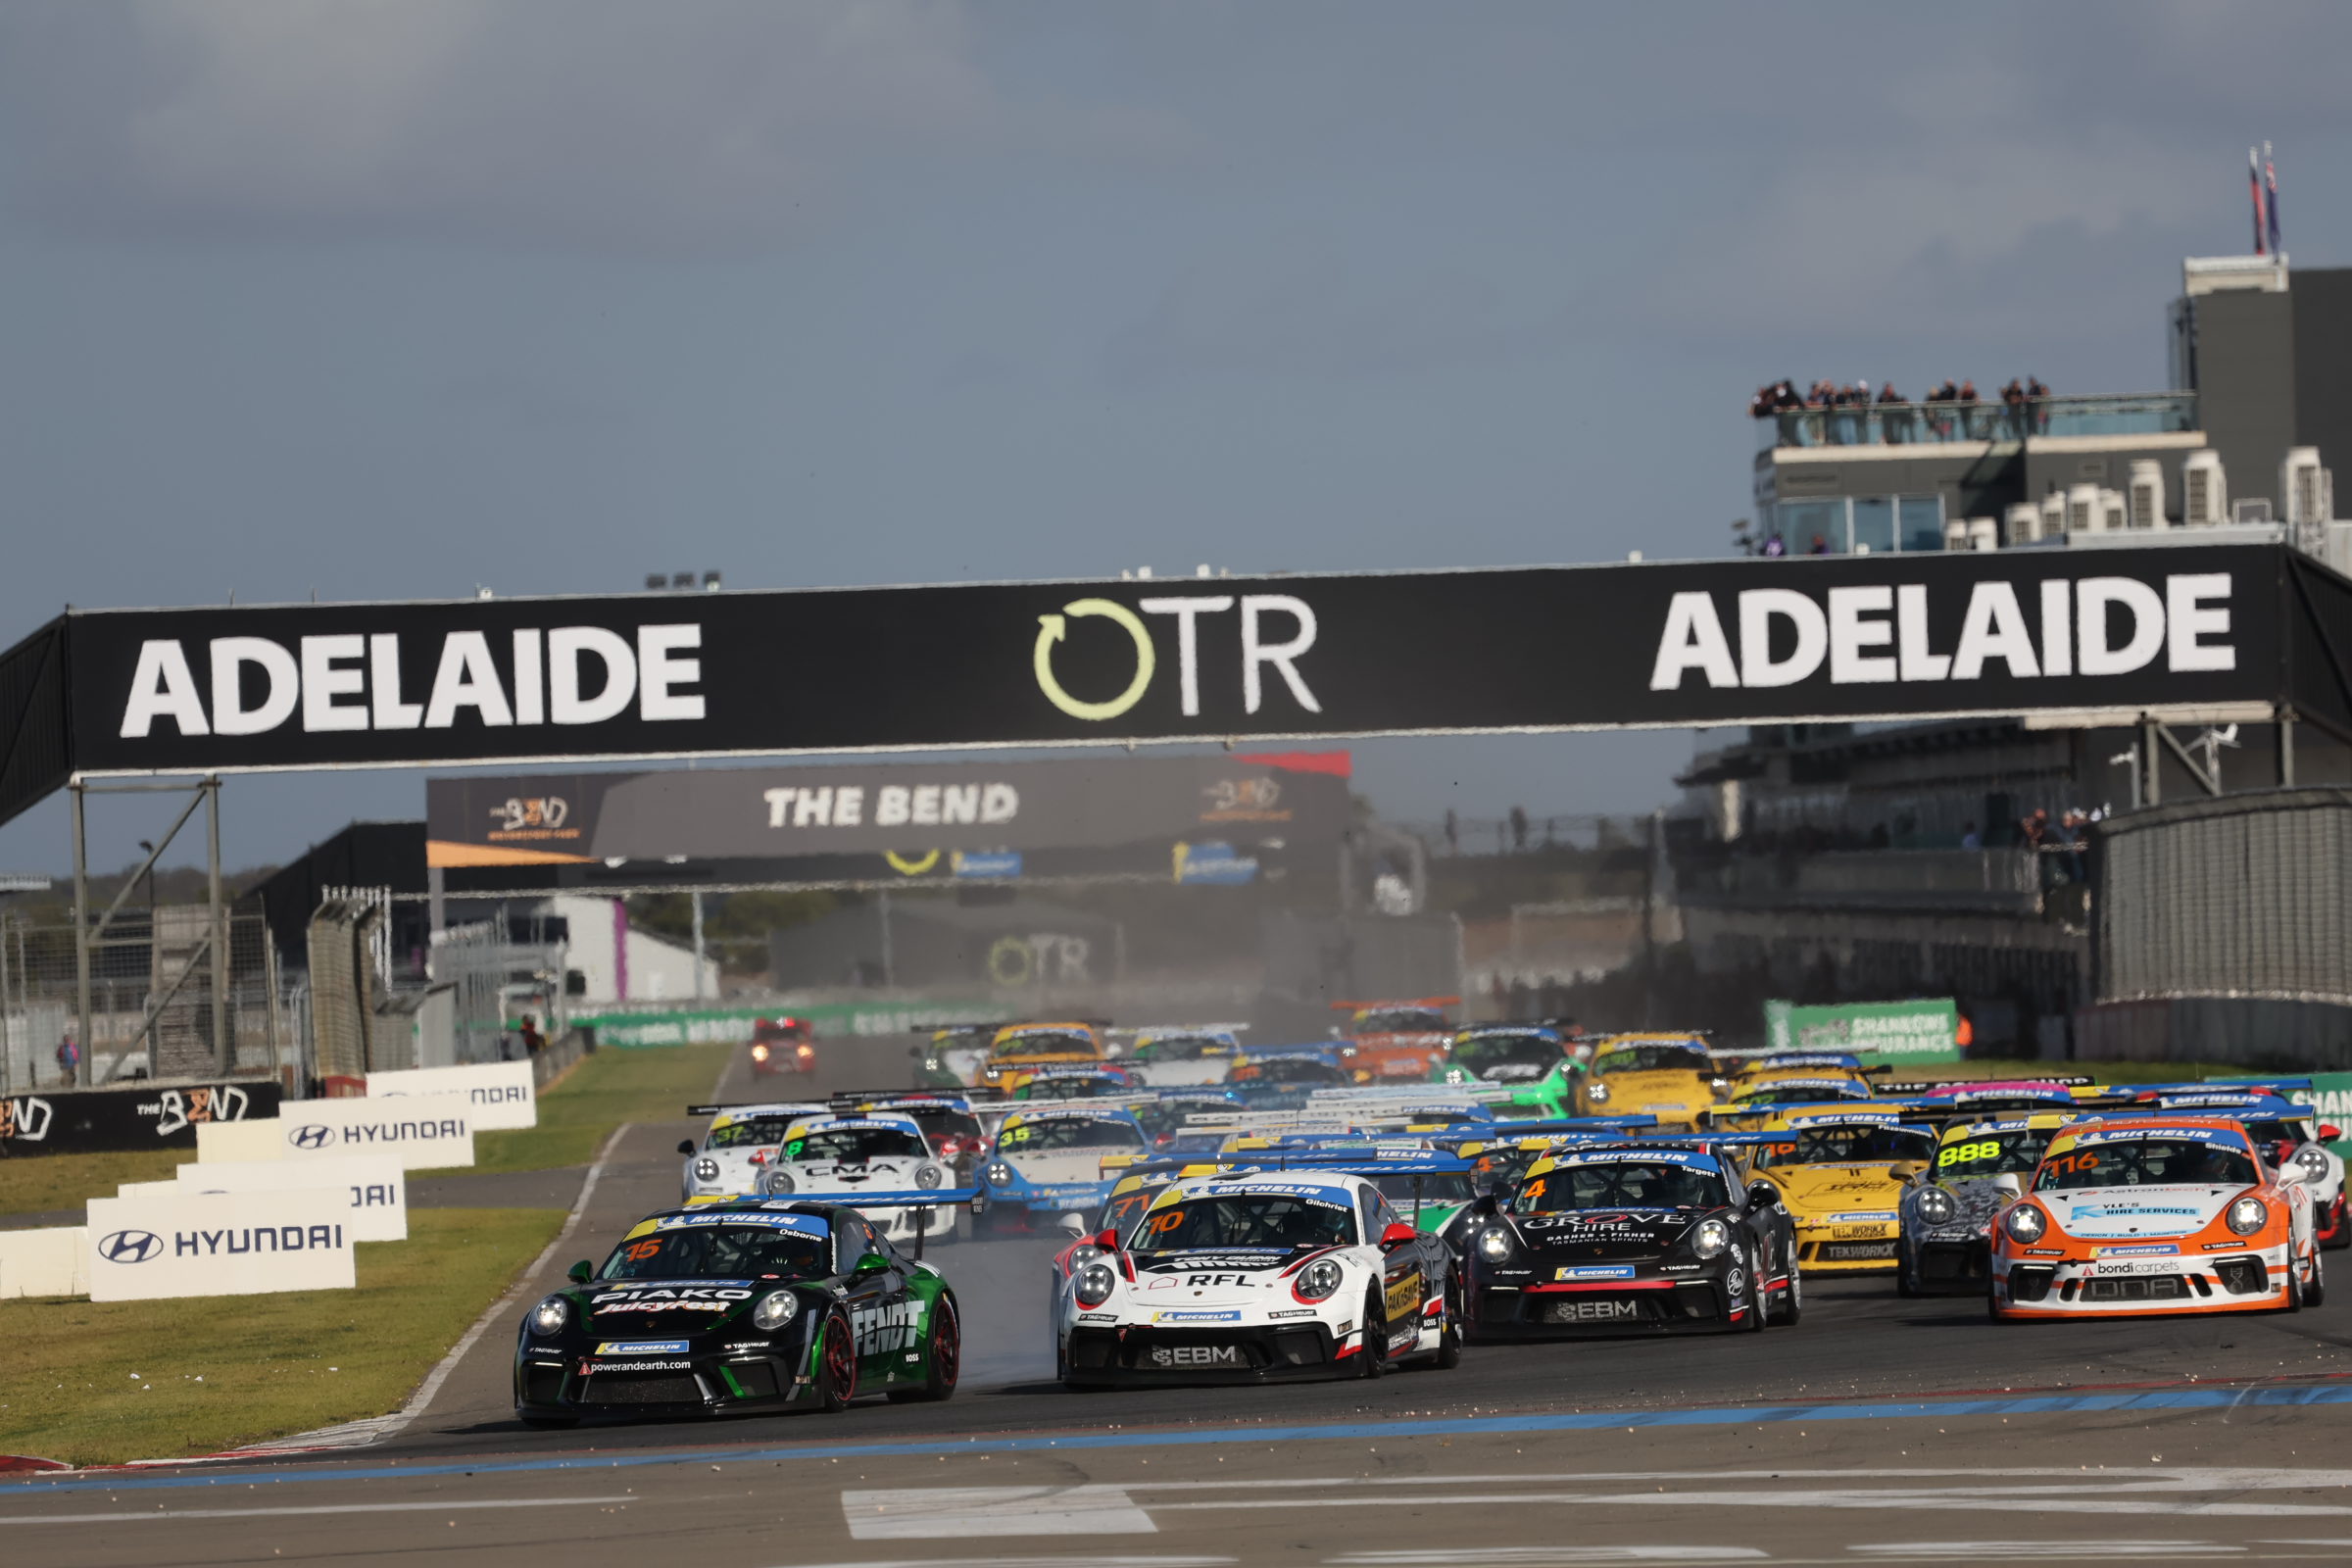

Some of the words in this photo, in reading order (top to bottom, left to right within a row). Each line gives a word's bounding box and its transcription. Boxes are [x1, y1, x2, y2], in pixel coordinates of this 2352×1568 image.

[1650, 573, 2235, 690] ADELAIDE
[1034, 595, 1322, 721] OTR
[121, 624, 707, 738] ADELAIDE
[764, 787, 863, 827] THE
[876, 784, 1018, 826] BEND
[988, 934, 1091, 987] OTR
[471, 1087, 527, 1104] NDAI
[2174, 1093, 2262, 1103] MICHELIN
[343, 1119, 466, 1144] HYUNDAI
[999, 1128, 1030, 1147] 35
[2108, 1129, 2213, 1139] MICHELIN
[787, 1141, 805, 1156] 8
[1377, 1151, 1433, 1159] HELIN
[1562, 1143, 1629, 1152] APEX
[1937, 1142, 2000, 1167] 888
[2205, 1142, 2242, 1154] Shields
[1586, 1153, 1689, 1162] MICHELIN
[806, 1163, 899, 1176] CMA
[1681, 1165, 1716, 1177] Targett
[2046, 1152, 2100, 1179] 116
[1215, 1184, 1322, 1195] MICHELIN
[1524, 1179, 1546, 1198] 4
[1114, 1194, 1151, 1218] 71
[1305, 1199, 1348, 1213] Gilchrist
[689, 1214, 799, 1225] MICHELIN
[1148, 1211, 1185, 1236] 10
[1524, 1213, 1686, 1229] GROVE
[779, 1228, 822, 1243] Osborne
[1573, 1223, 1631, 1233] HIRE
[175, 1224, 342, 1257] HYUNDAI
[1551, 1237, 1607, 1246] TASMANIAN
[625, 1239, 662, 1262] 15
[1828, 1243, 1896, 1258] TEKWORKX
[2098, 1260, 2133, 1274] bondi
[2135, 1260, 2180, 1276] carpets
[1187, 1274, 1255, 1287] RFL
[591, 1289, 753, 1303] PIAKO
[1578, 1299, 1638, 1318] EBM
[852, 1300, 925, 1358] FENDT
[1423, 1318, 1436, 1327] BOSS
[622, 1343, 681, 1351] MICHELIN
[1176, 1345, 1236, 1363] EBM
[906, 1353, 919, 1362] BOSS
[591, 1360, 691, 1371] powerandearth.com
